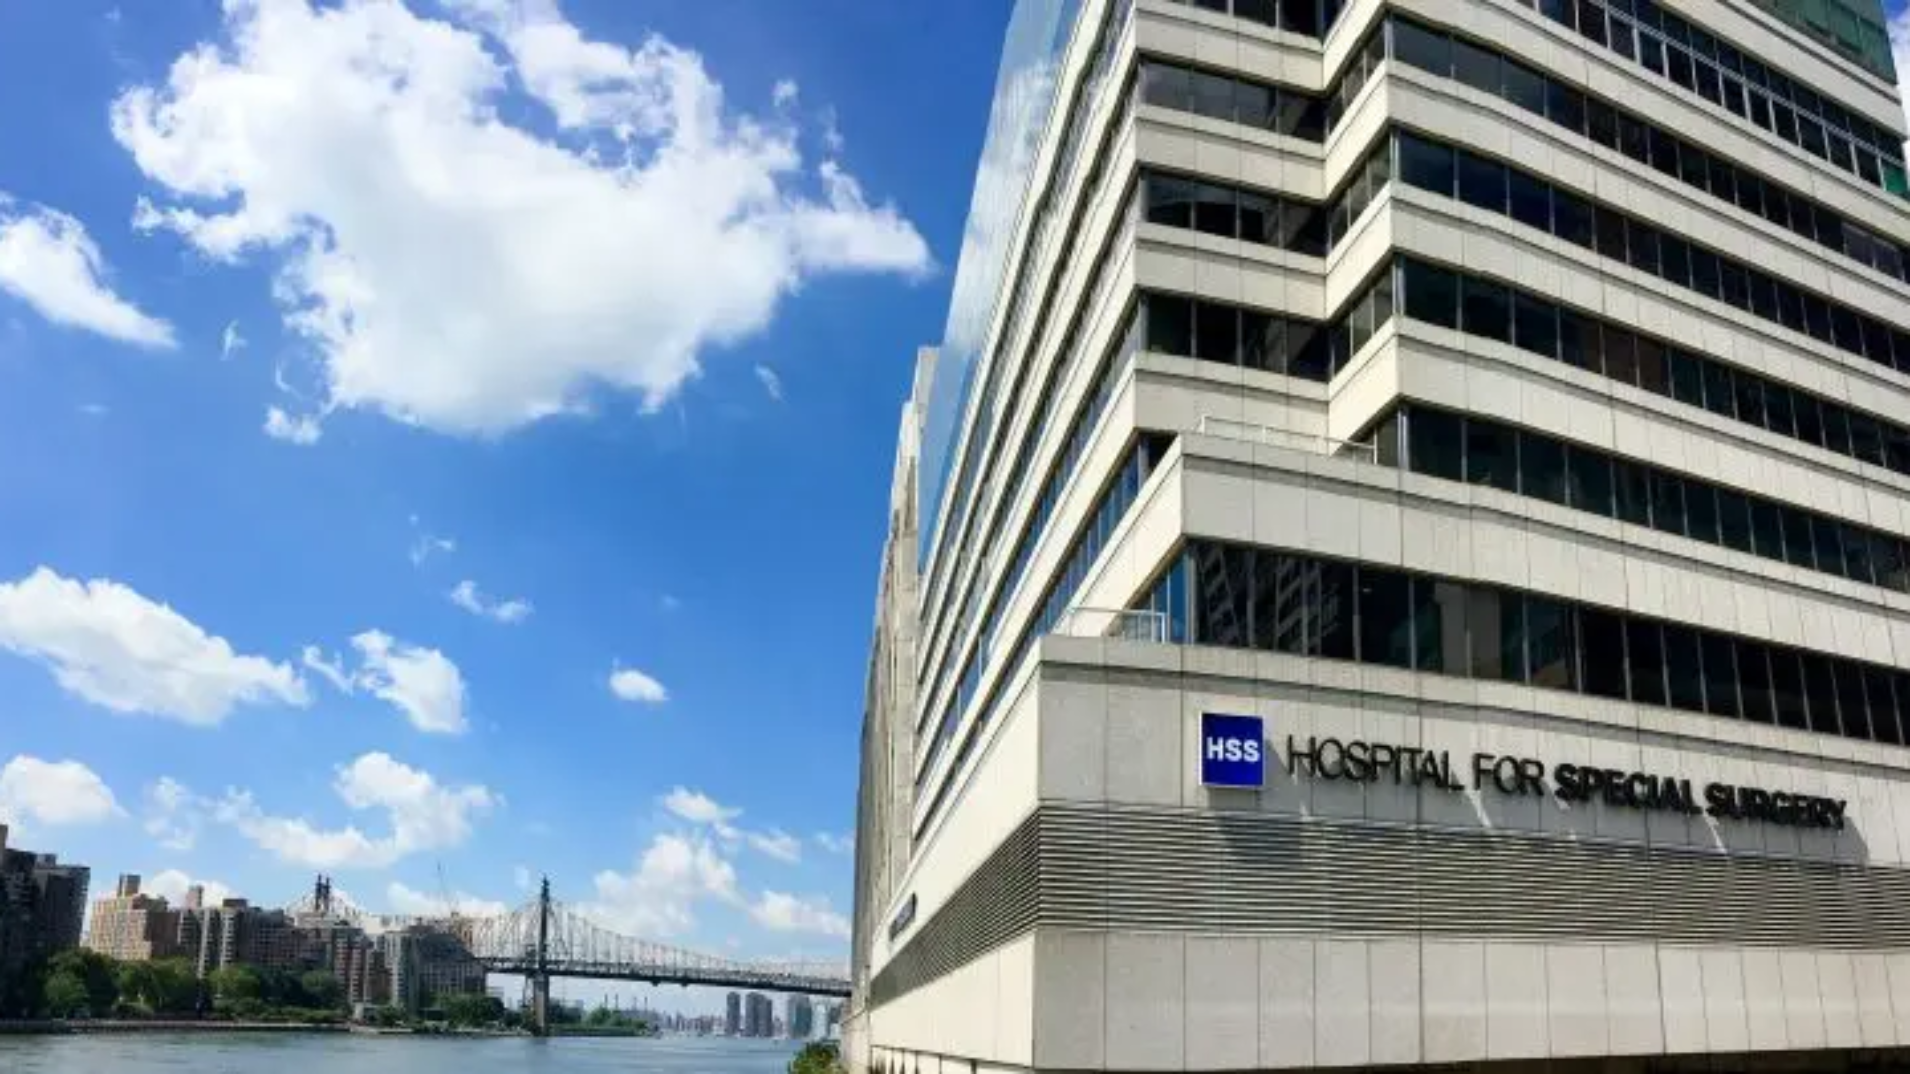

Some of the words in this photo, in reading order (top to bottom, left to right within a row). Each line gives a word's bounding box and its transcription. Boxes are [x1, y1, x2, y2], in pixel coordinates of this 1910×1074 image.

[1206, 736, 1260, 763] HSS
[1286, 734, 1465, 791] HOSPITAL
[1472, 752, 1545, 797] FOR
[1553, 763, 1702, 816] SPECIAL
[1703, 782, 1847, 830] SURGERY
